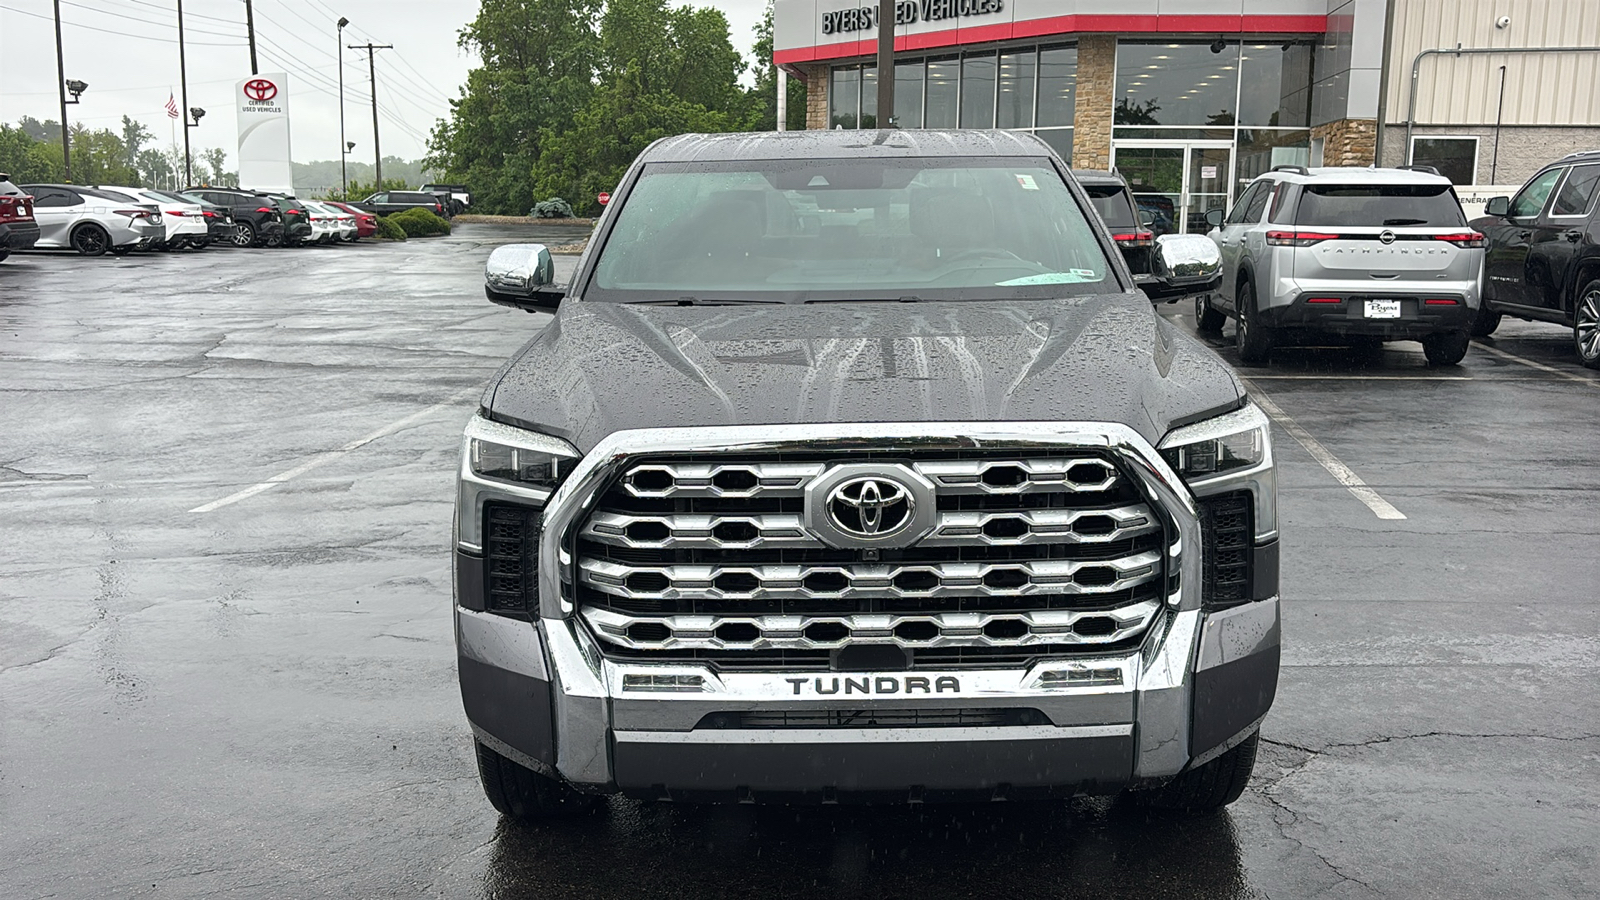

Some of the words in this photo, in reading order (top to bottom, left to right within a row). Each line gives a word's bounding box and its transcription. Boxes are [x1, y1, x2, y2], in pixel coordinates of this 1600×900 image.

[822, 6, 872, 34] BYERS
[872, 1, 918, 28] UED
[919, 0, 1003, 21] VEHICLES
[1322, 246, 1449, 255] PATHFINDER
[785, 676, 961, 695] TUNDRA
